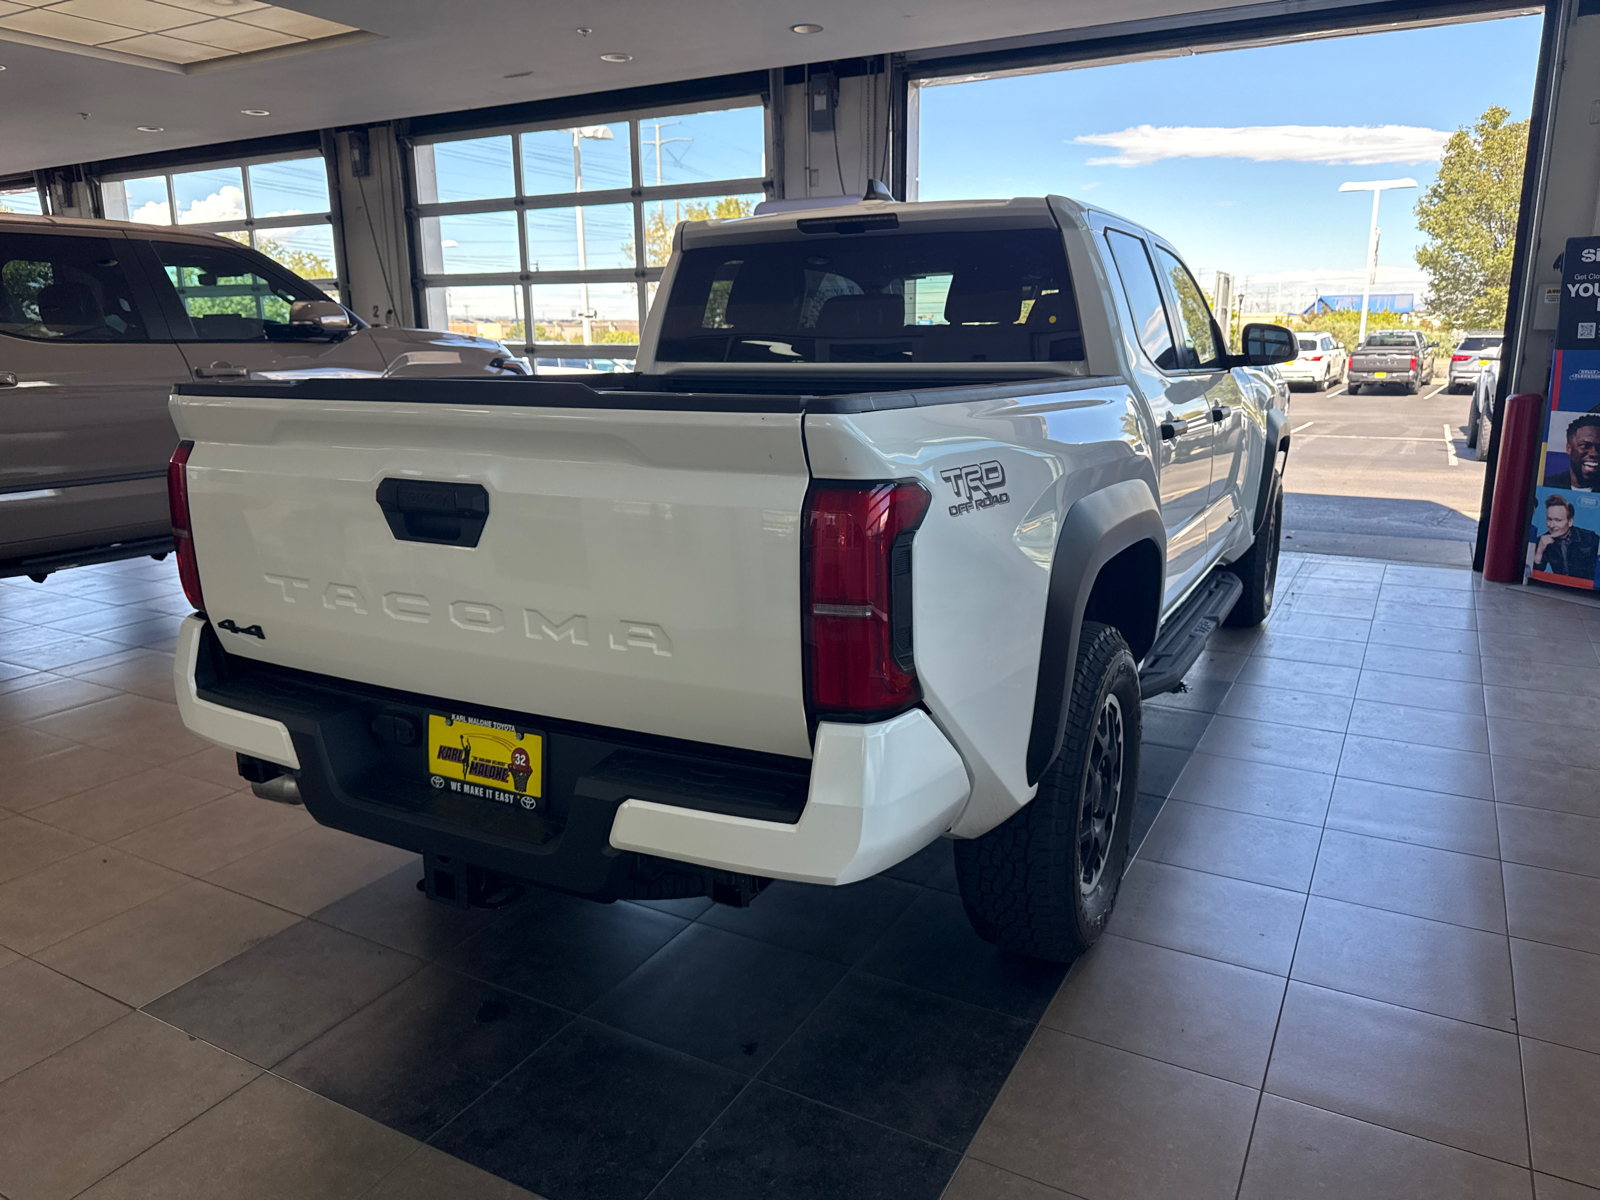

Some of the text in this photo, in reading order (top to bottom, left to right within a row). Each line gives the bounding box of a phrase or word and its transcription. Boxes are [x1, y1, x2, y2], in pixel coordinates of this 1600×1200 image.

[1574, 273, 1587, 281] Get
[372, 305, 380, 318] 2
[940, 460, 1006, 502] TRD
[948, 492, 1010, 517] OFF ROAD
[263, 572, 673, 657] TACOMA
[451, 713, 516, 732] KARL MALONE TOYOTA
[437, 745, 464, 764] KARL
[514, 753, 526, 766] 32
[469, 761, 511, 783] MALONE
[450, 781, 514, 804] WE MAKE IT EASY
